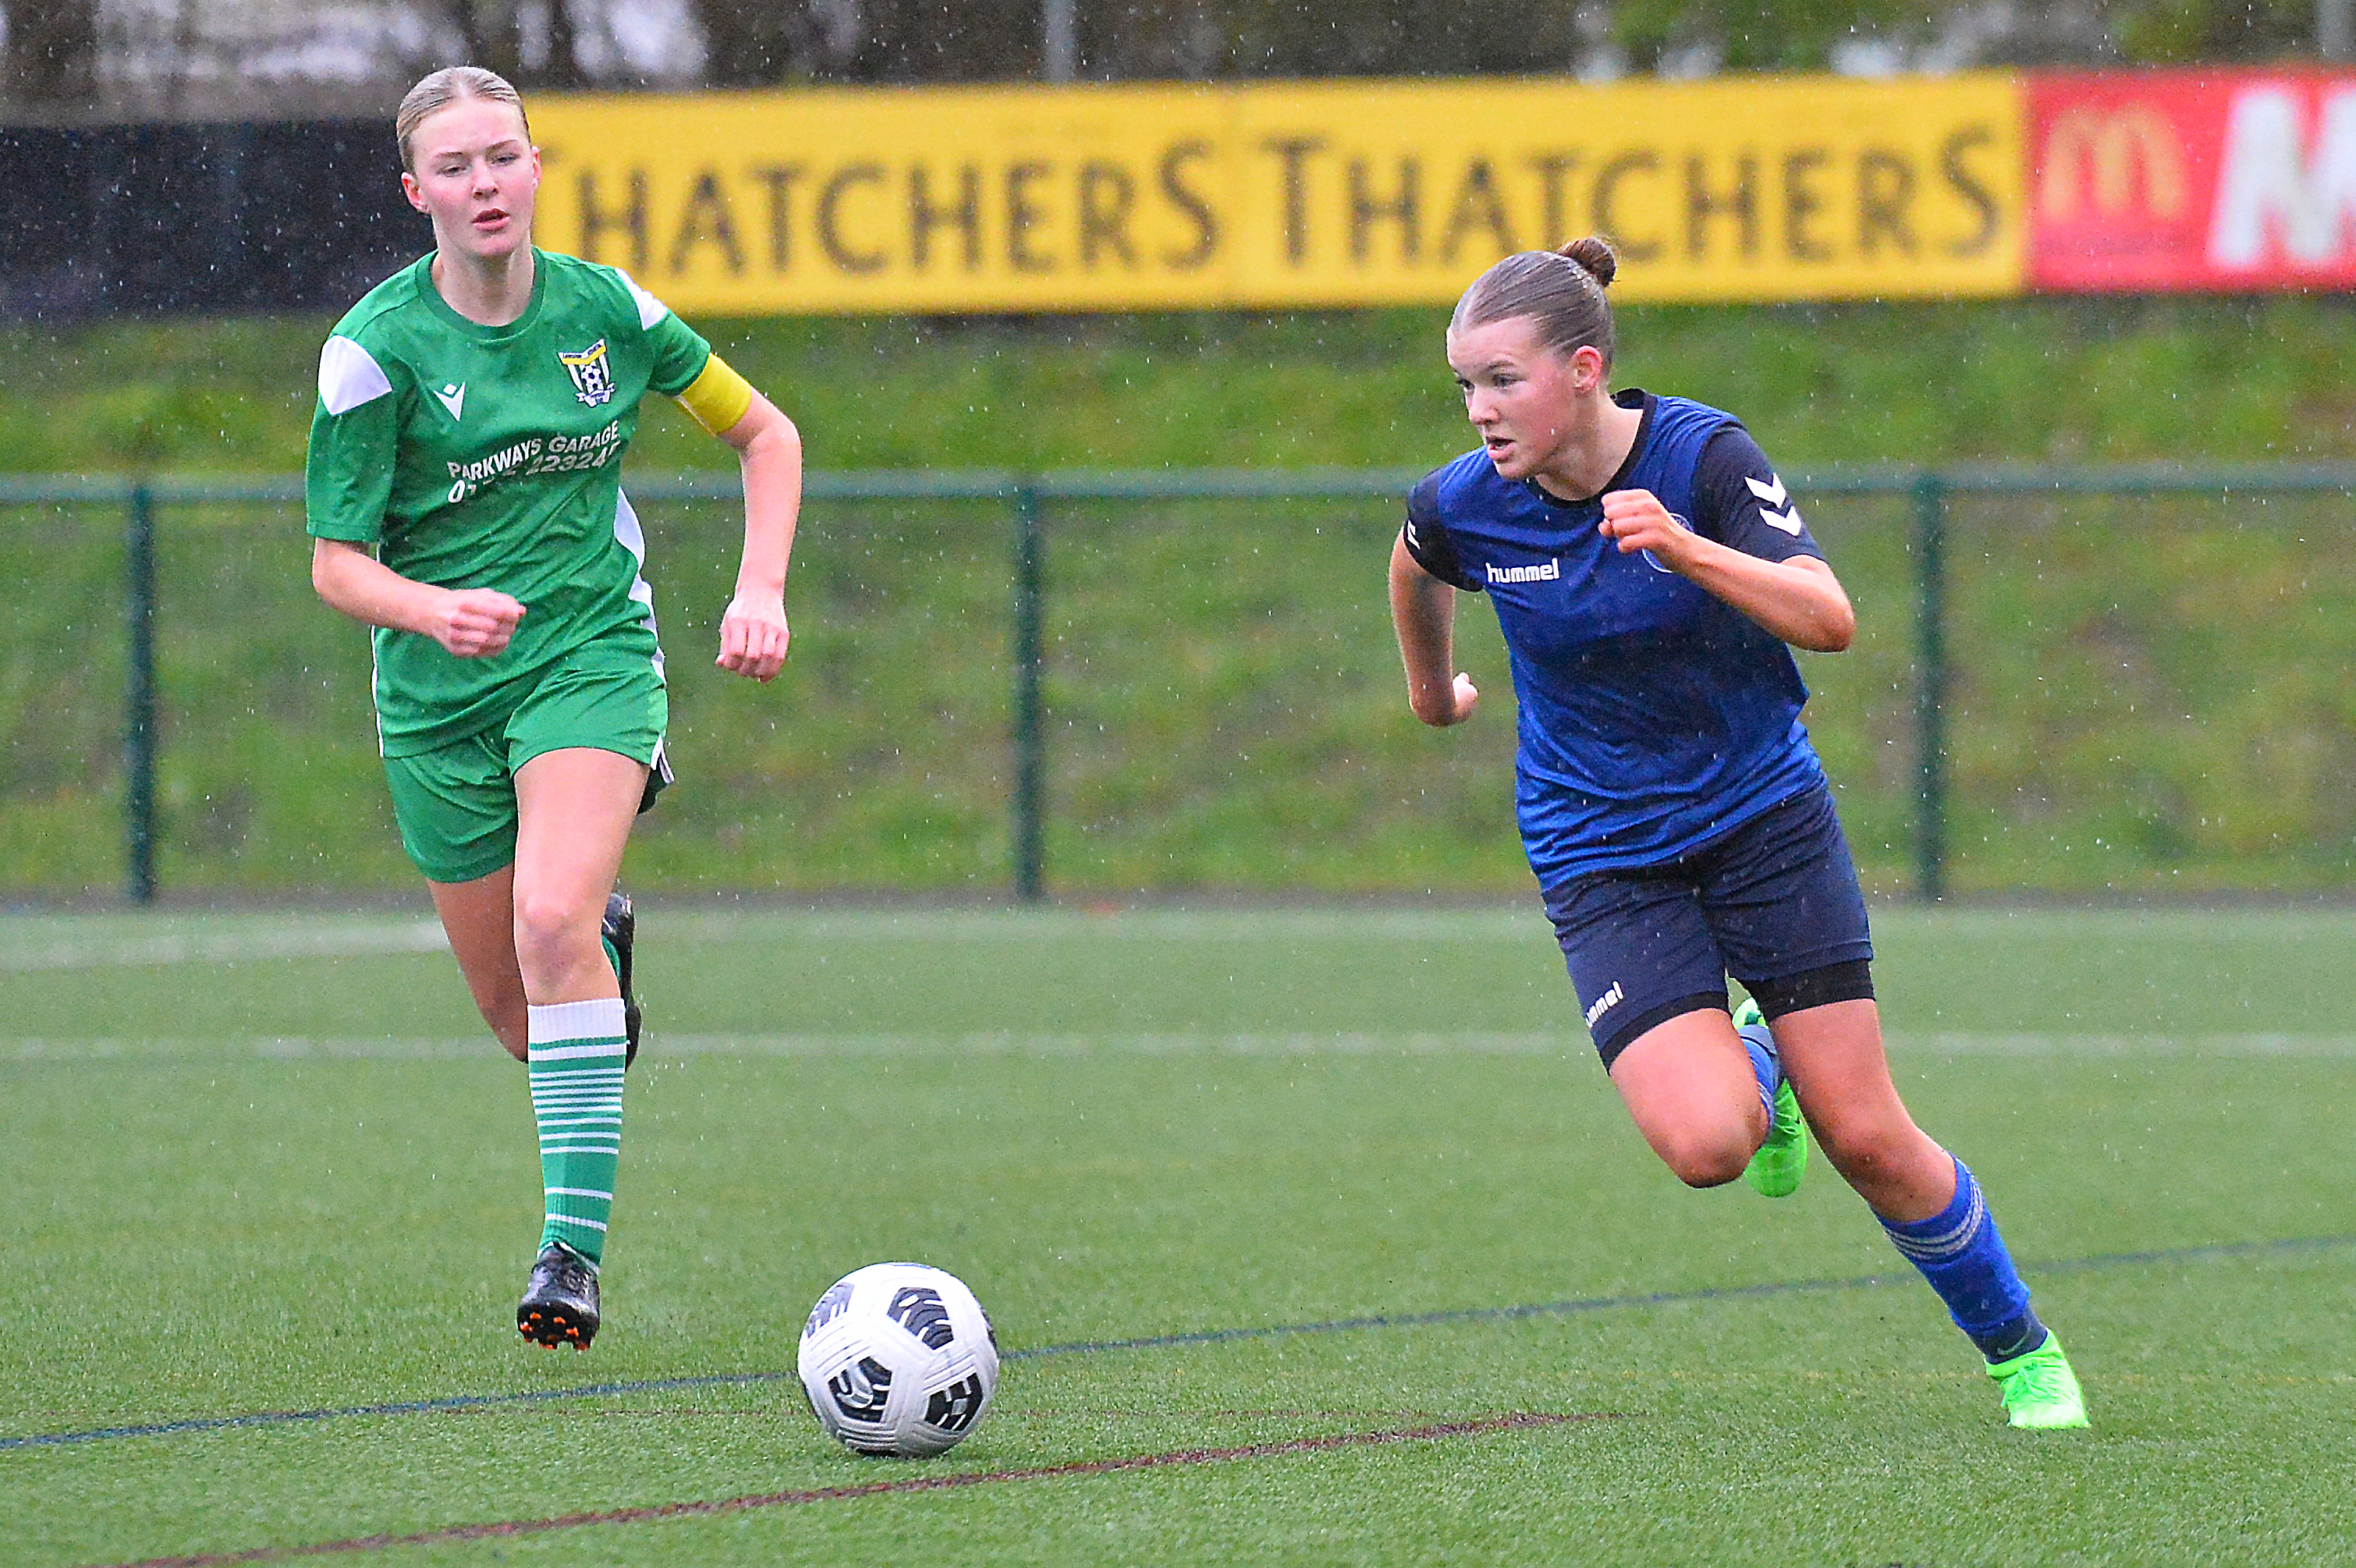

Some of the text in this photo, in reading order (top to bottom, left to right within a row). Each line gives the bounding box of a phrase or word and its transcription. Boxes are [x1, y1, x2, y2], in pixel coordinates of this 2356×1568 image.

[541, 137, 1222, 279] HATCHERS
[1264, 123, 2003, 270] THATCHERS
[447, 420, 618, 481] PARKWAYS GARAGE
[1485, 558, 1559, 583] hummel
[1586, 981, 1623, 1027] ummel
